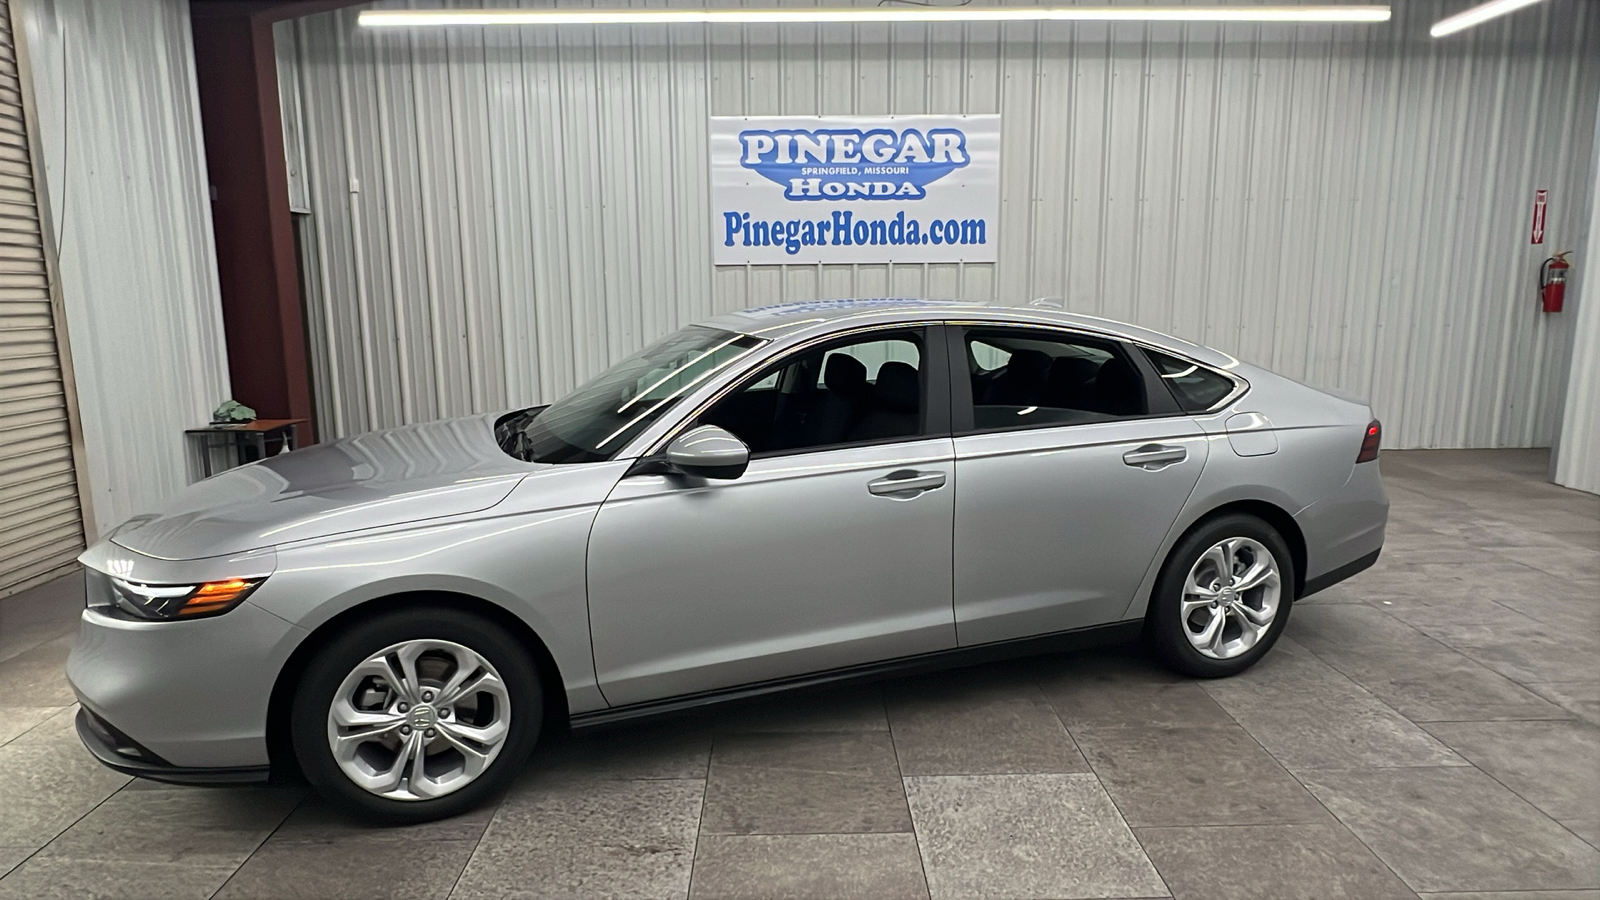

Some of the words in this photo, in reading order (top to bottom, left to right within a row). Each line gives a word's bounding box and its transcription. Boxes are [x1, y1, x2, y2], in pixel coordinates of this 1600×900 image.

[744, 133, 967, 165] PINEGAR
[801, 167, 862, 176] SPRINGFIELD,
[864, 167, 909, 175] MISSOURI
[789, 178, 921, 196] HONDA
[723, 210, 987, 255] PinegarHonda.com
